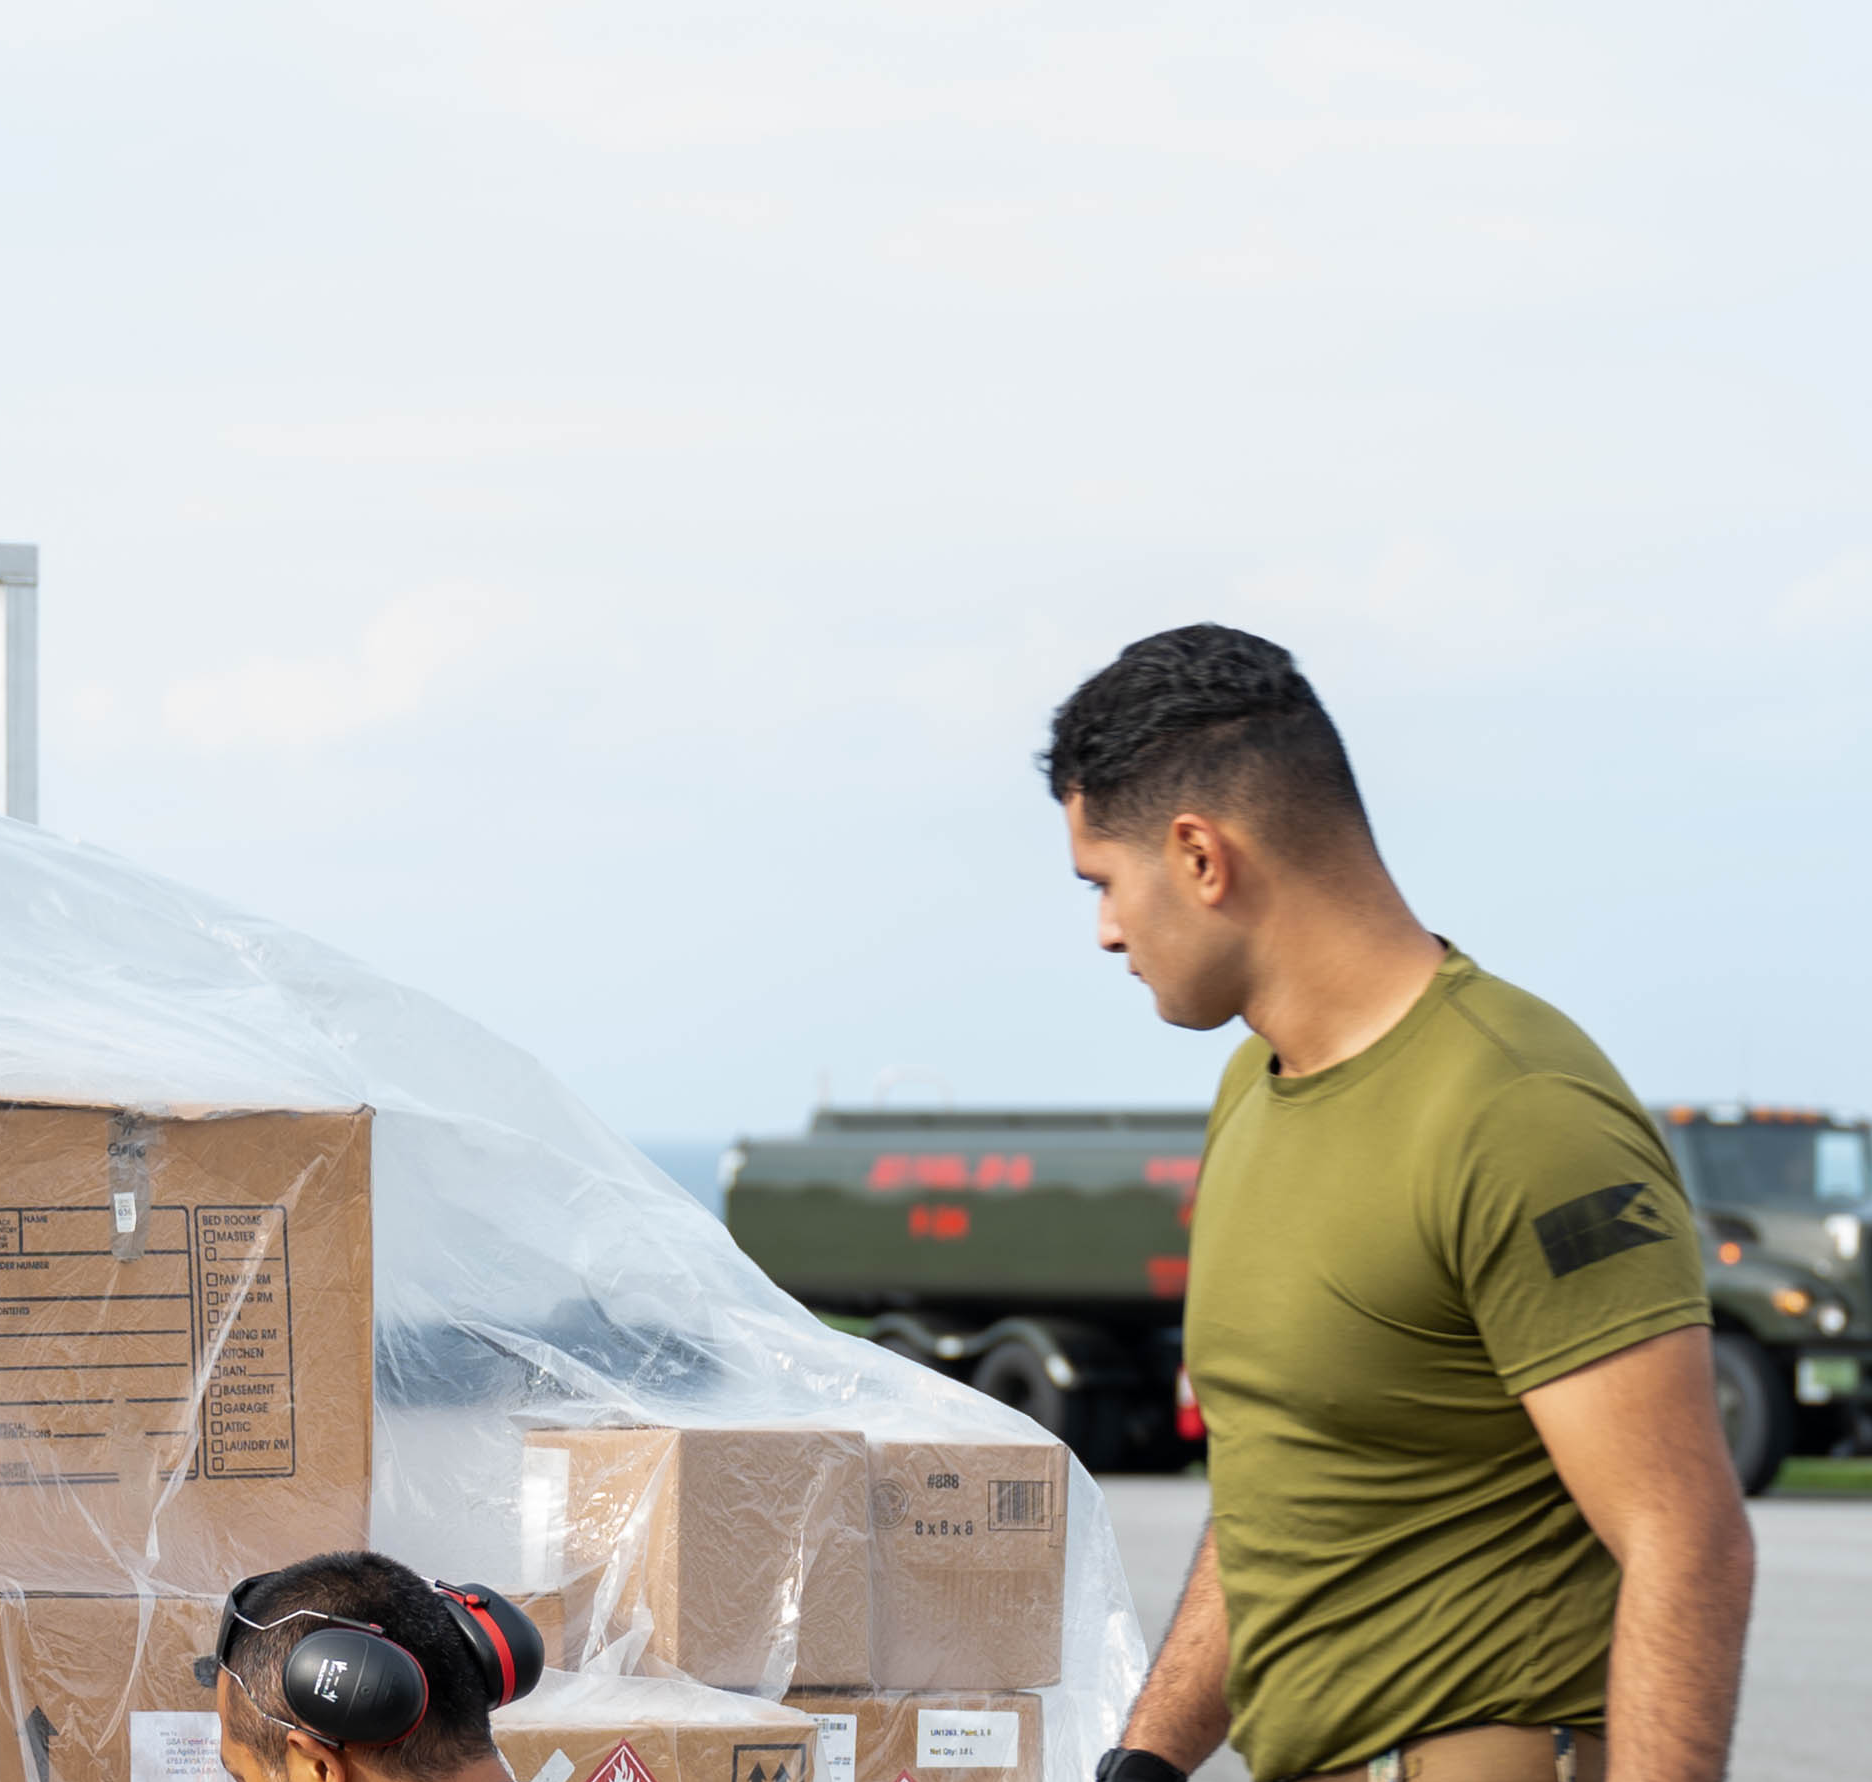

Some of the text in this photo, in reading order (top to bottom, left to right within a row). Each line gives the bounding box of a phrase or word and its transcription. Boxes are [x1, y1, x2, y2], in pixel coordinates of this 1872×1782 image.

[24, 1215, 48, 1224] NAME
[202, 1215, 262, 1226] BED ROOMS
[217, 1231, 256, 1242] MASTER
[16, 1261, 50, 1270] NUMBER
[256, 1273, 271, 1285] RM
[256, 1292, 273, 1303] RM
[261, 1328, 277, 1340] RM
[222, 1348, 264, 1359] KITCHEN
[222, 1366, 247, 1377] BATH
[223, 1384, 274, 1396] BASEMENT
[224, 1402, 268, 1414] GARAGE
[224, 1421, 251, 1432] ATTIC
[224, 1440, 290, 1452] LAUNDRY RM
[927, 1473, 960, 1489] #888
[915, 1520, 923, 1536] 8
[940, 1520, 948, 1535] 8
